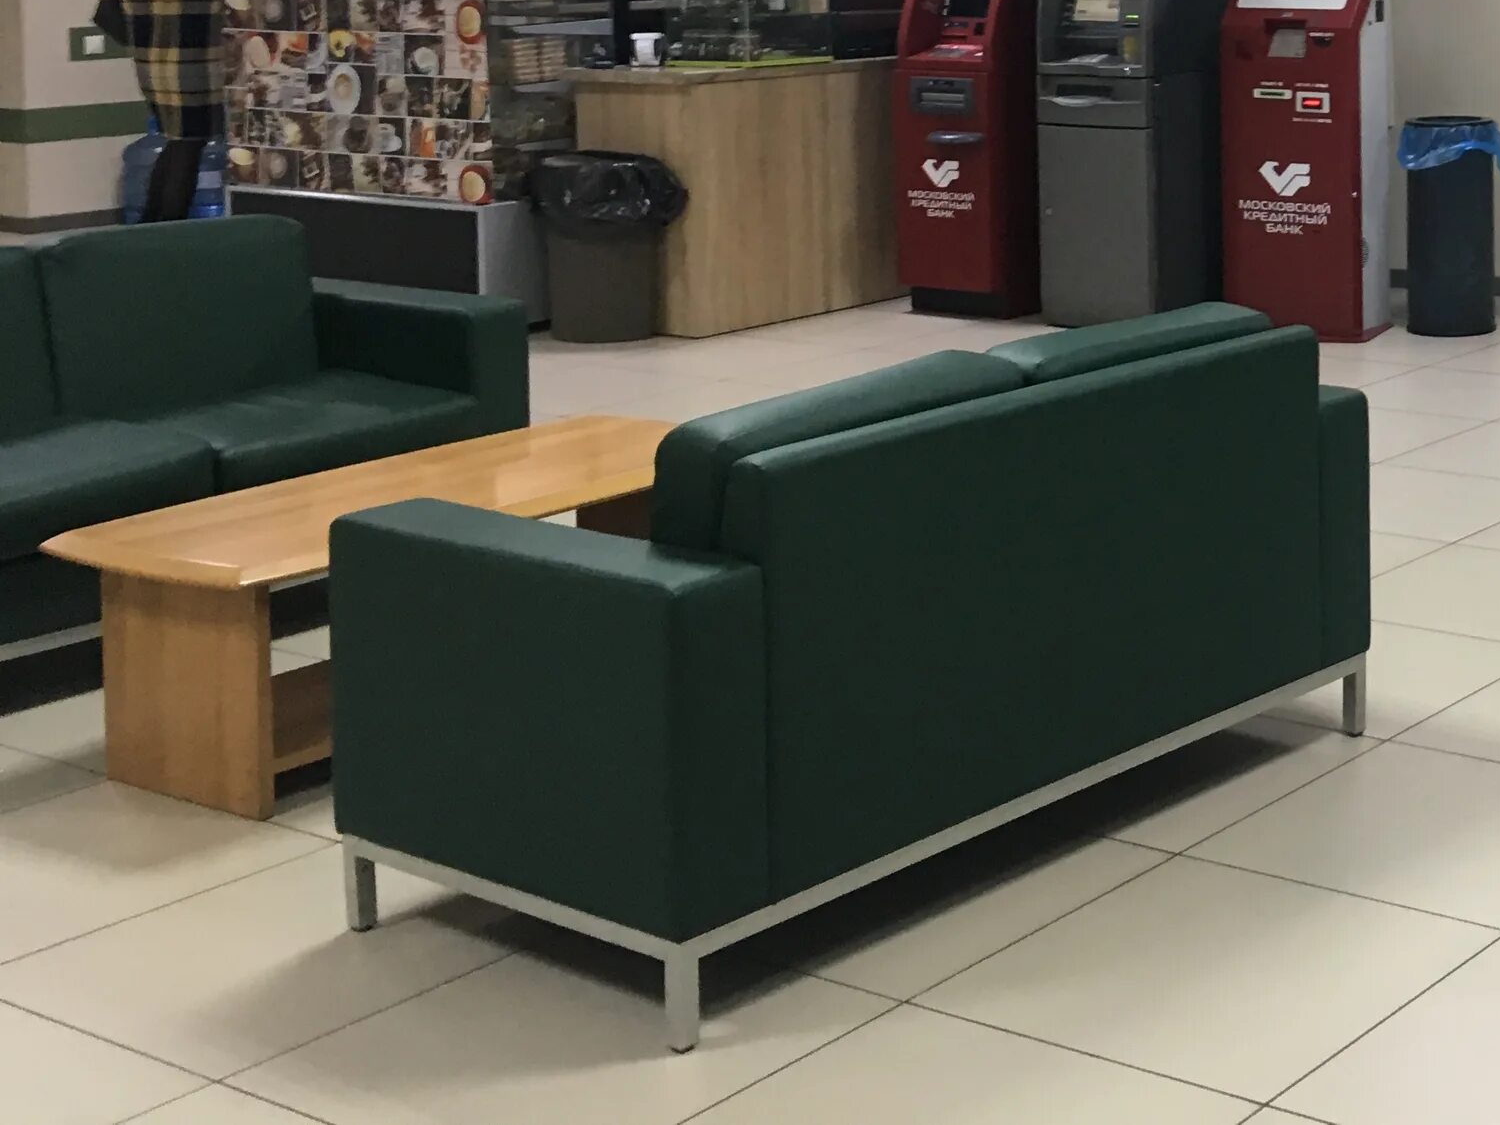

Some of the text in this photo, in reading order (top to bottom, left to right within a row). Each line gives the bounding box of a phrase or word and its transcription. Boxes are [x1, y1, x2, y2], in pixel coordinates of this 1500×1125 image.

[907, 190, 975, 202] МОСКОВСКИЙ
[911, 199, 972, 210] КРЕДИТНЫЙ
[1238, 199, 1331, 214] МОСКОВСКИЙ
[926, 208, 955, 218] БАНК
[1243, 211, 1328, 225] КРЕДИТНЫЙ
[1265, 223, 1303, 235] БАНК
